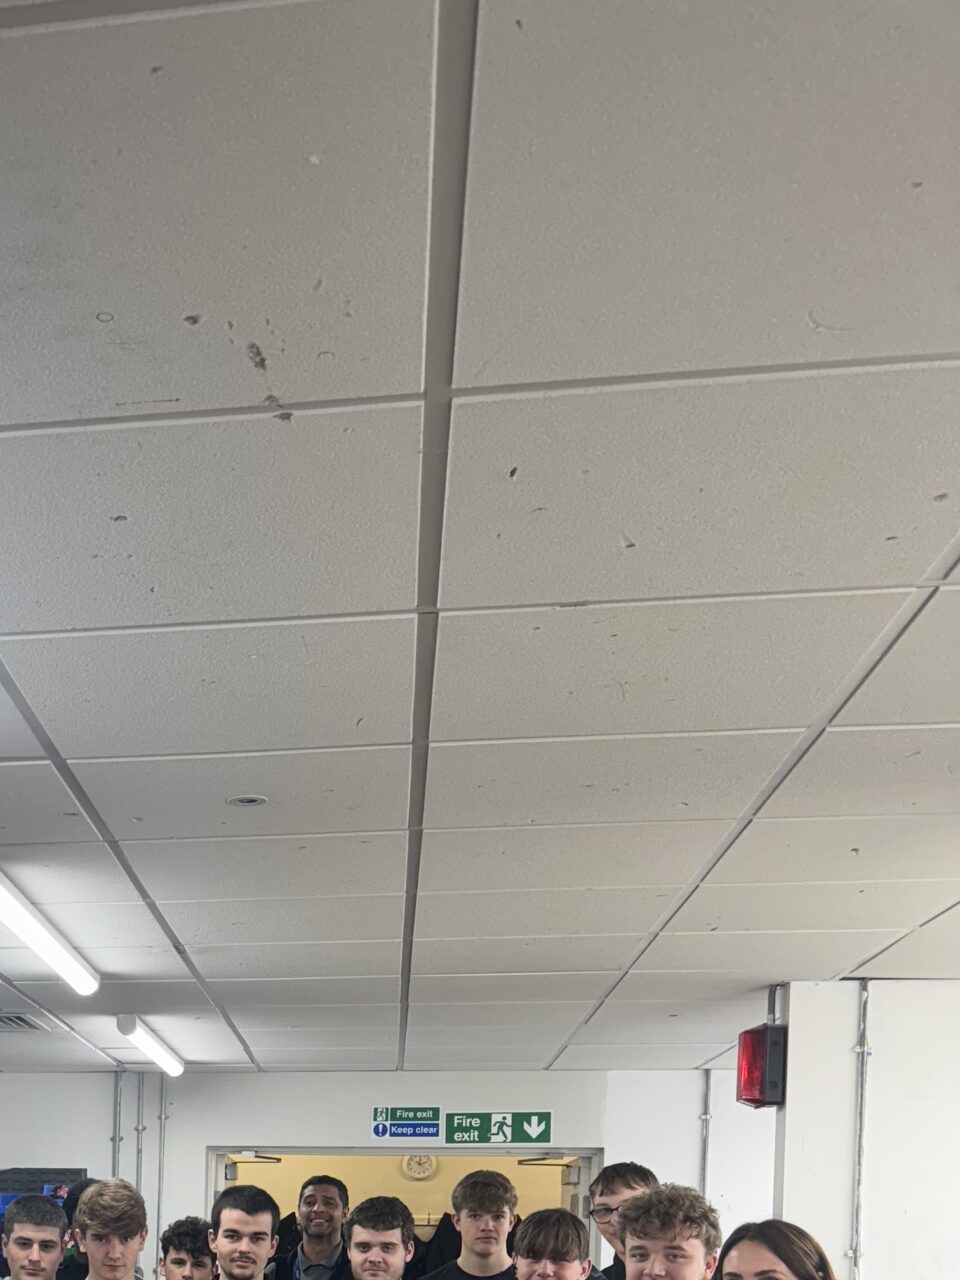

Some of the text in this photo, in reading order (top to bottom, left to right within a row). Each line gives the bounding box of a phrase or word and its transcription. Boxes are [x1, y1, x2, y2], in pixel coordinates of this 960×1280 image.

[396, 1109, 433, 1118] Fire exit
[453, 1115, 481, 1127] Fire
[391, 1125, 438, 1136] Keep clear
[453, 1129, 480, 1141] exit
